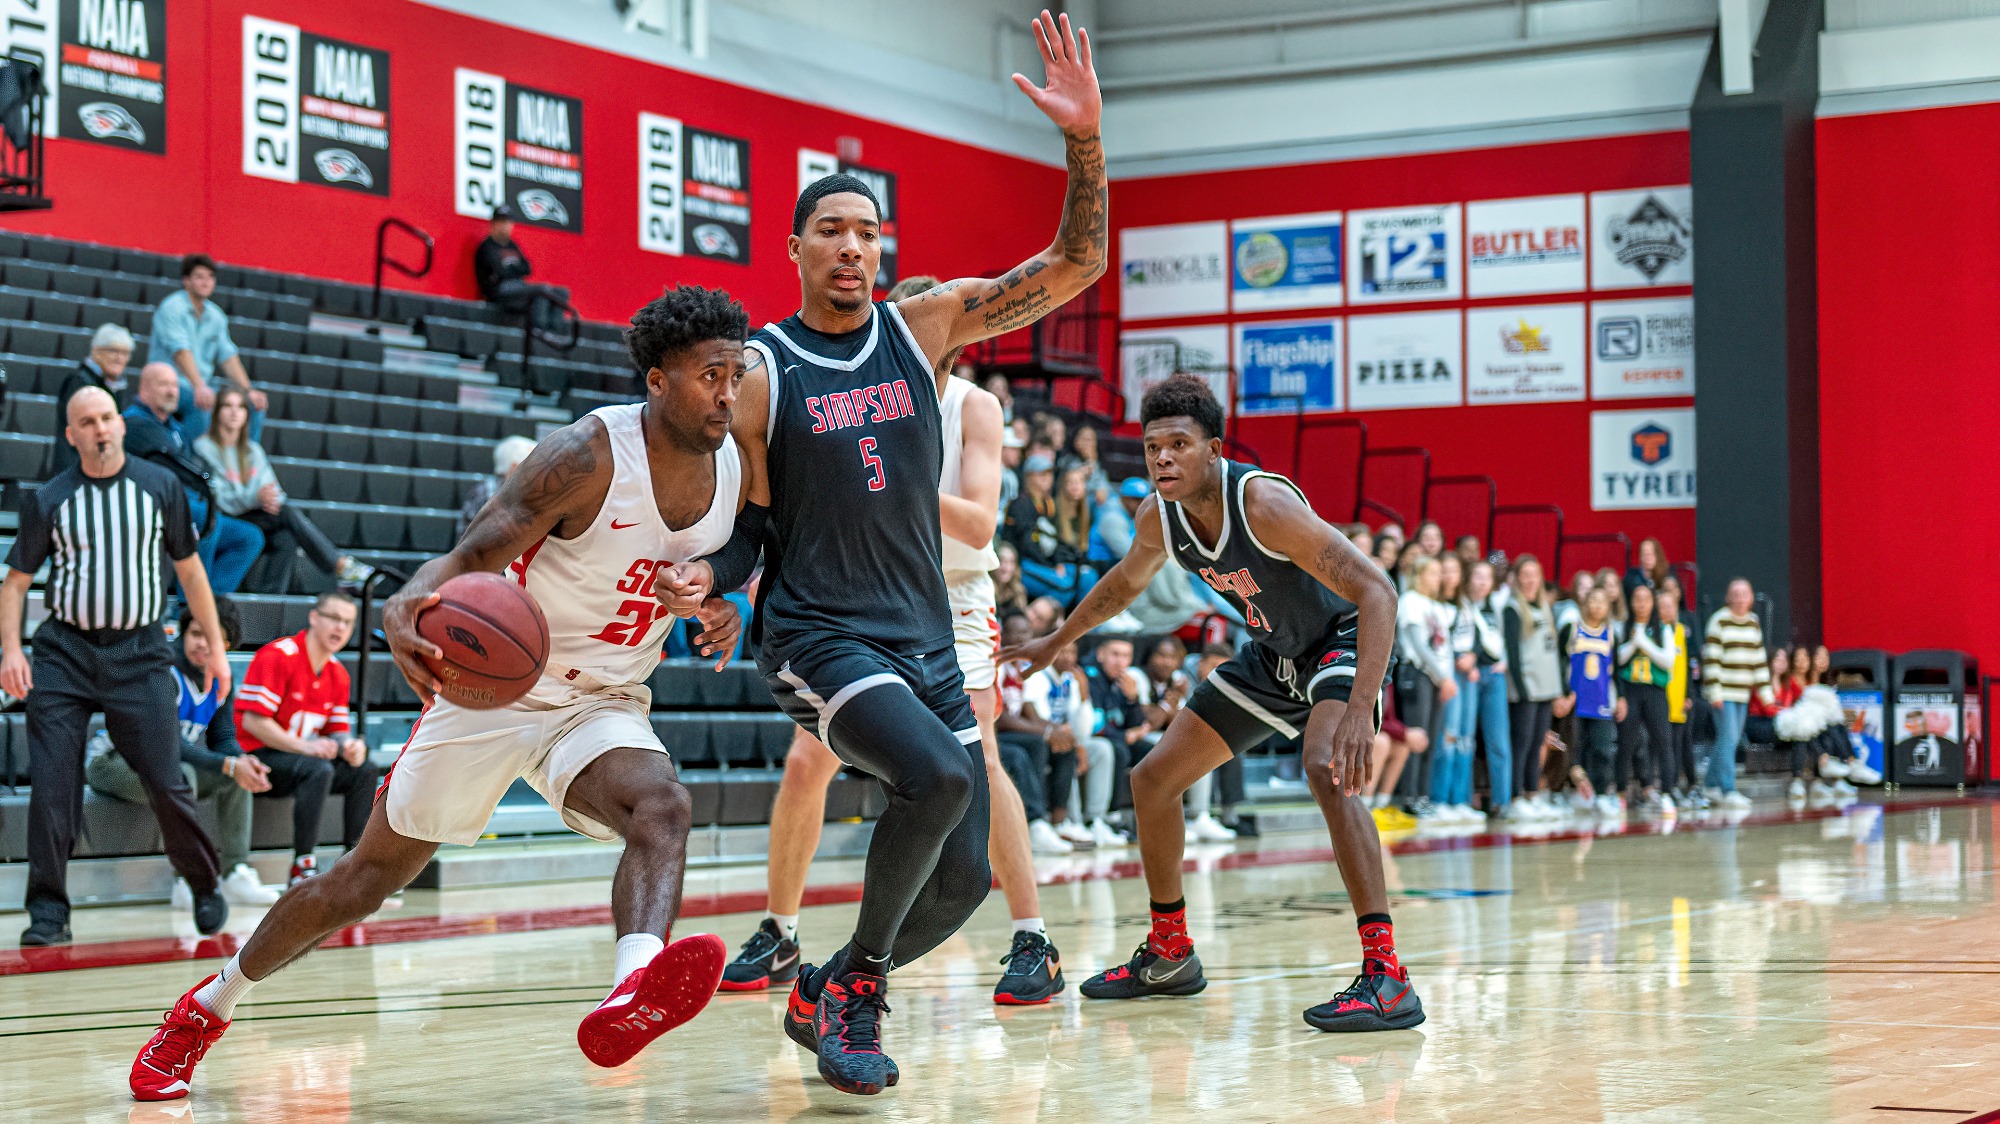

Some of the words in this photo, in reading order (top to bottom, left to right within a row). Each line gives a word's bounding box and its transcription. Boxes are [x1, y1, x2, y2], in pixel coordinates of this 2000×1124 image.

[78, 0, 149, 58] NAIA
[257, 31, 288, 168] 2016
[314, 42, 376, 108] NAIA
[467, 83, 494, 208] 2018
[517, 91, 571, 151] NAIA
[650, 127, 672, 241] 2019
[692, 133, 741, 189] NAIA
[1364, 235, 1434, 280] 12
[1472, 226, 1580, 256] BUTLER
[1358, 358, 1451, 386] PIZZA
[805, 379, 915, 434] SIMPSON
[858, 437, 886, 491] 5
